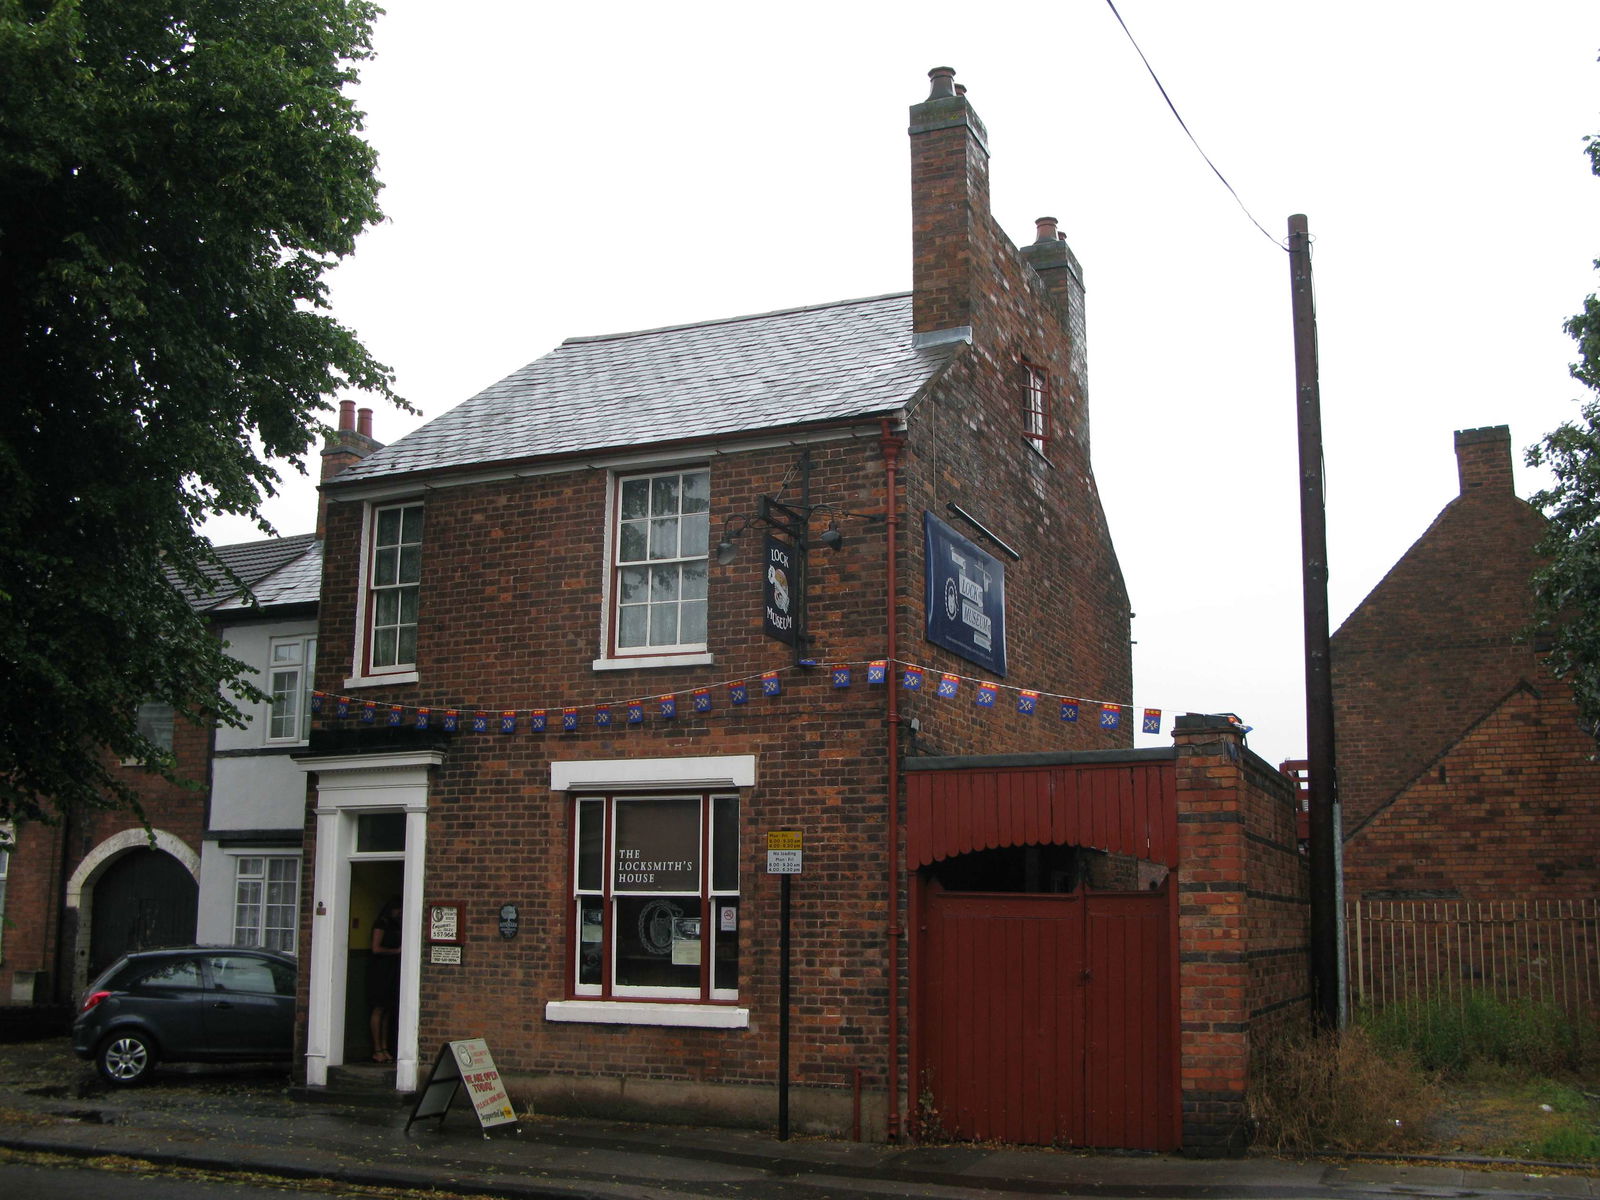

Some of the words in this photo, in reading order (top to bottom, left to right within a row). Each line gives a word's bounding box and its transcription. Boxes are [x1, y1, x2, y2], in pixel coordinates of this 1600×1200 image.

[771, 549, 789, 568] LOCK
[962, 579, 979, 601] LOCK
[767, 606, 792, 630] MUSEUM
[964, 607, 990, 632] MUSEUM
[619, 850, 640, 859] THE
[618, 861, 693, 871] LOCKSMITH'S
[618, 873, 655, 883] HOUSE
[483, 1071, 499, 1081] OPEN
